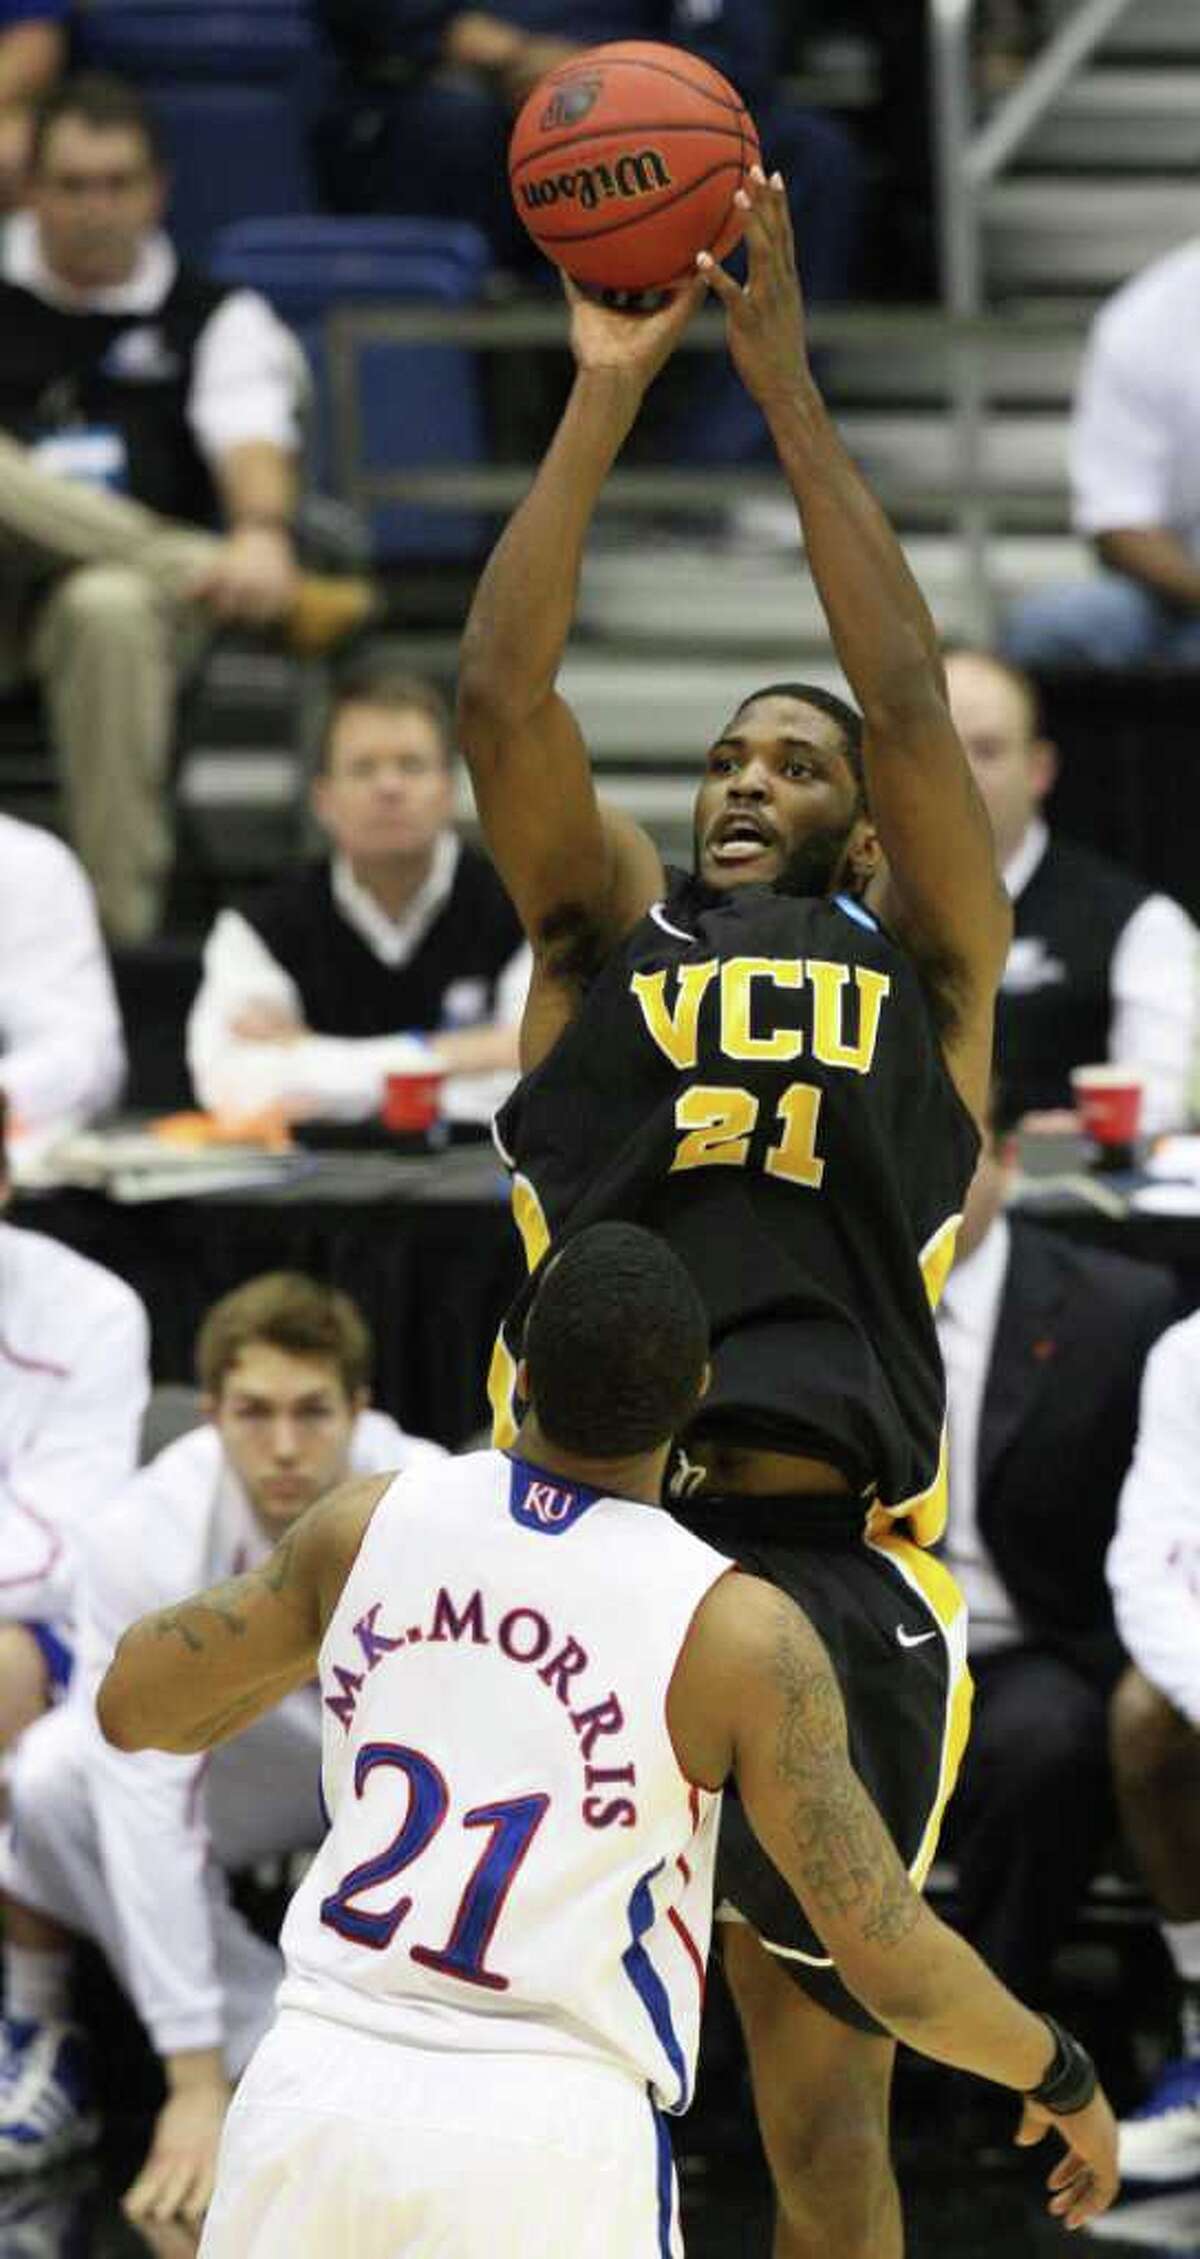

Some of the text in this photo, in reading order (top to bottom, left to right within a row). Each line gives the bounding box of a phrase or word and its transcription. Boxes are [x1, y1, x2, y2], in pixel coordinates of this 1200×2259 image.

[519, 150, 671, 209] Wilson
[629, 957, 890, 1074] VCU
[669, 1083, 826, 1190] 21
[523, 1480, 572, 1524] KU
[320, 1742, 551, 1991] 21
